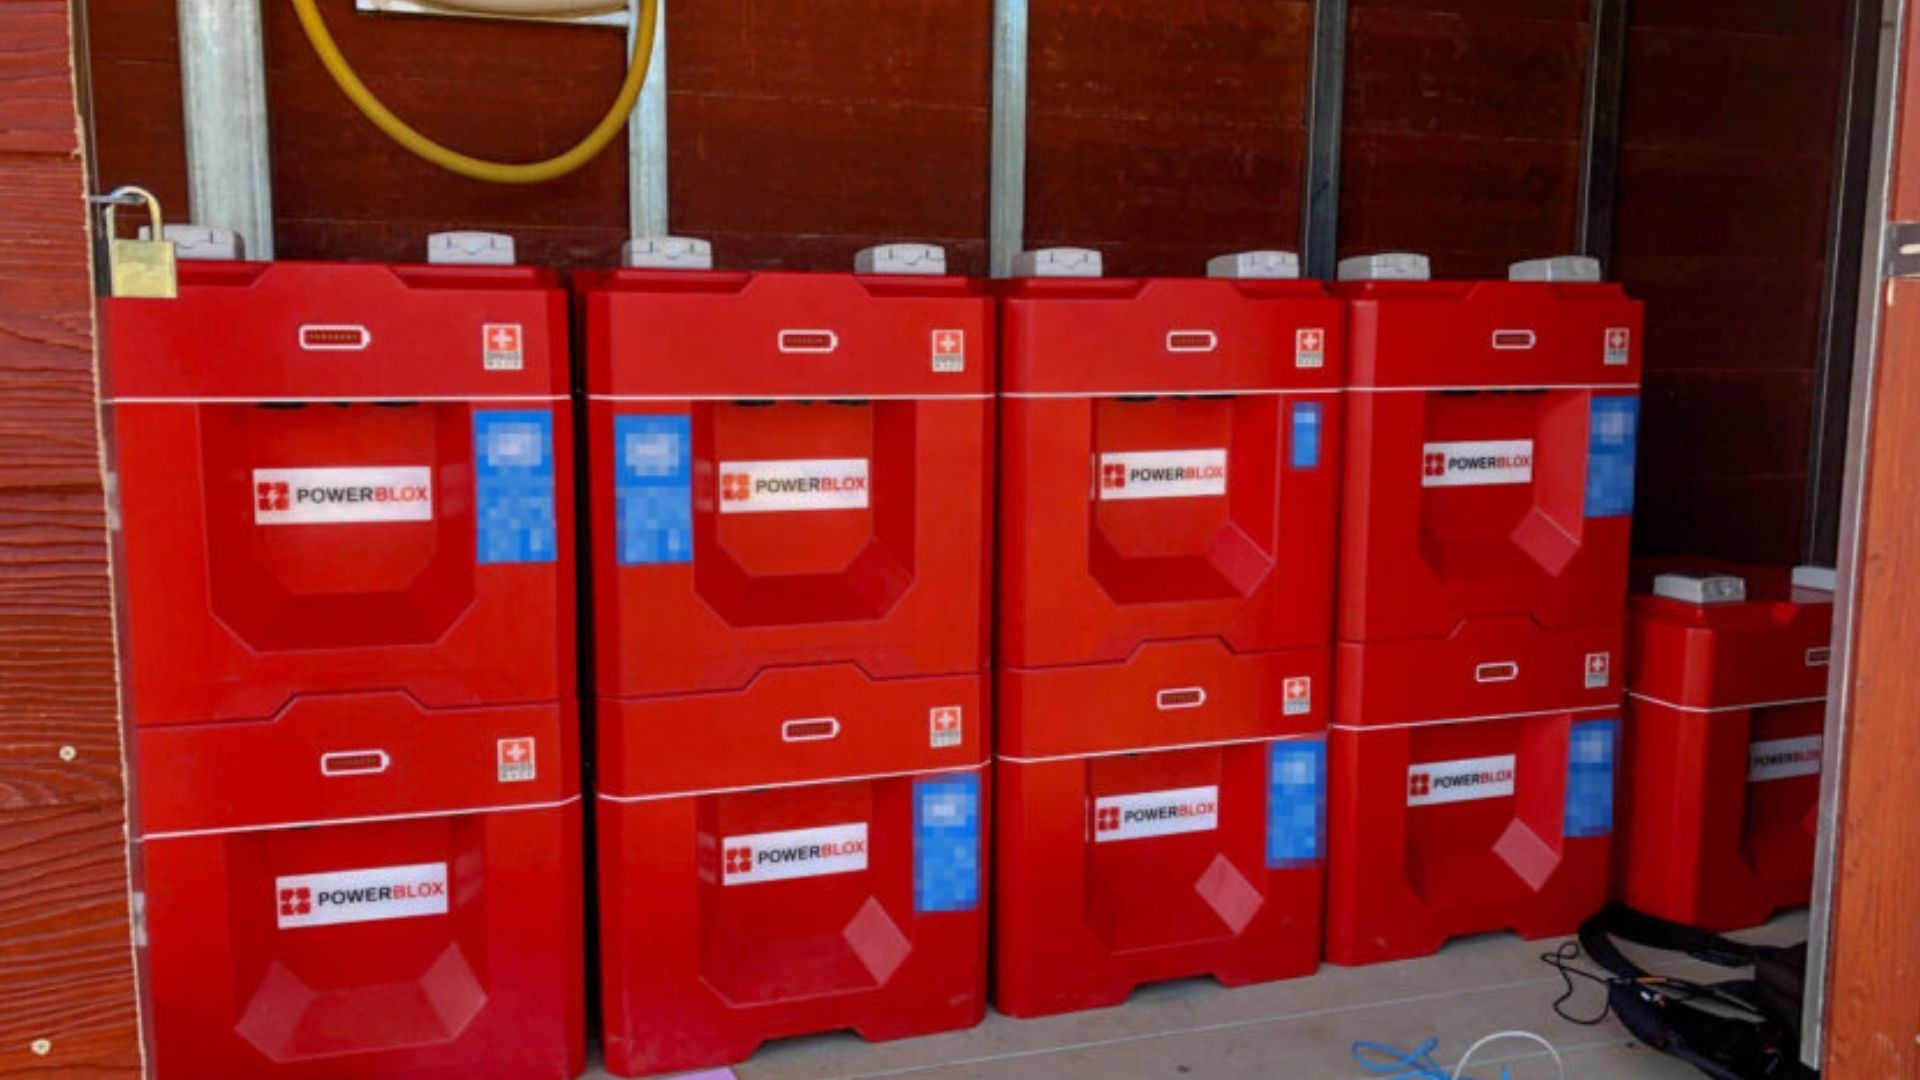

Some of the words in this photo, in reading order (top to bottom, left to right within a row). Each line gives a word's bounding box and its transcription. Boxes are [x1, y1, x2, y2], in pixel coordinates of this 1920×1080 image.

[1449, 457, 1530, 470] POWERBLOX
[1130, 466, 1223, 482] POWERBLOX
[756, 476, 866, 493] POWERBLOX
[296, 486, 428, 504] POWERBLOX
[1433, 769, 1512, 789] POWERBLOX
[1124, 802, 1215, 823] POWERBLOX
[757, 840, 865, 864] POWERBLOX
[317, 881, 444, 906] POWERBLOX
